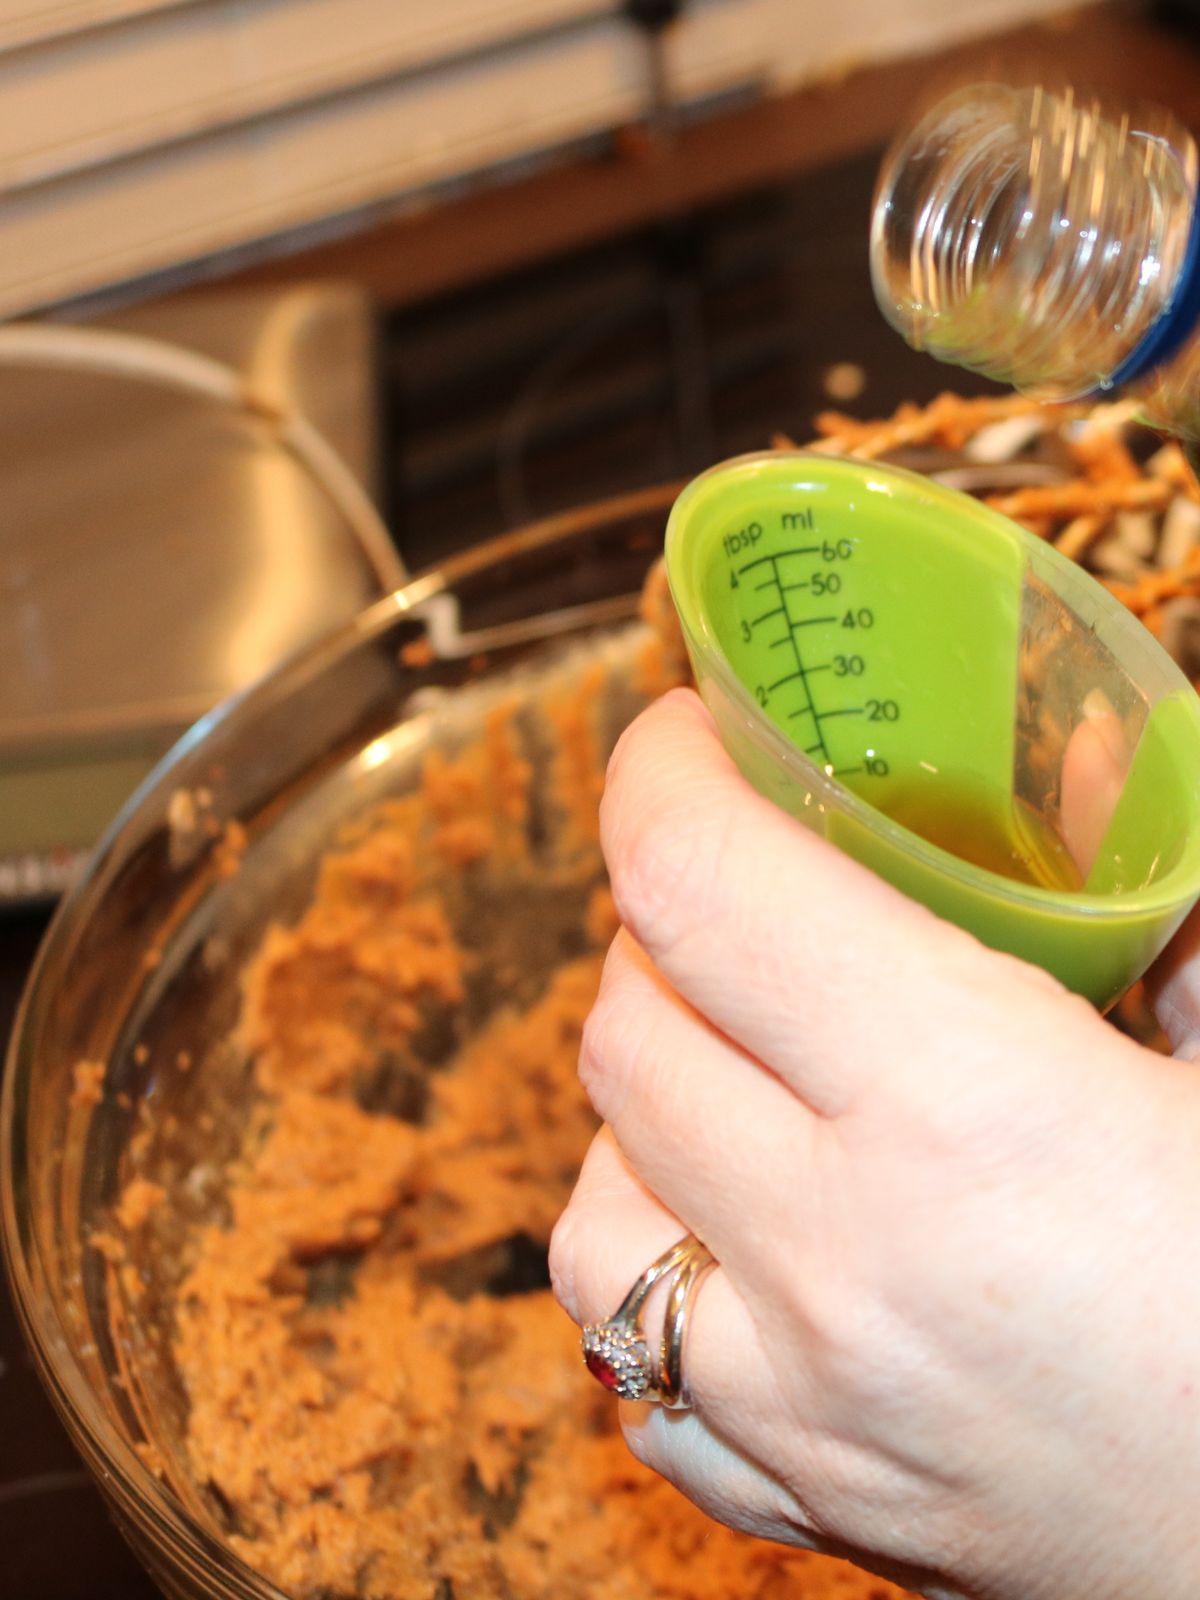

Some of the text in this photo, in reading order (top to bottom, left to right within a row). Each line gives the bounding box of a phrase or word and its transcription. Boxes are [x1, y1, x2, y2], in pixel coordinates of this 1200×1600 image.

[781, 508, 813, 530] ml
[722, 521, 763, 558] tbsp
[821, 539, 852, 562] 60
[811, 573, 841, 596] 50
[841, 608, 874, 630] 40
[740, 620, 752, 643] 3
[833, 655, 865, 677] 30
[756, 685, 769, 708] 2
[865, 700, 900, 722] 20
[863, 758, 889, 778] 10
